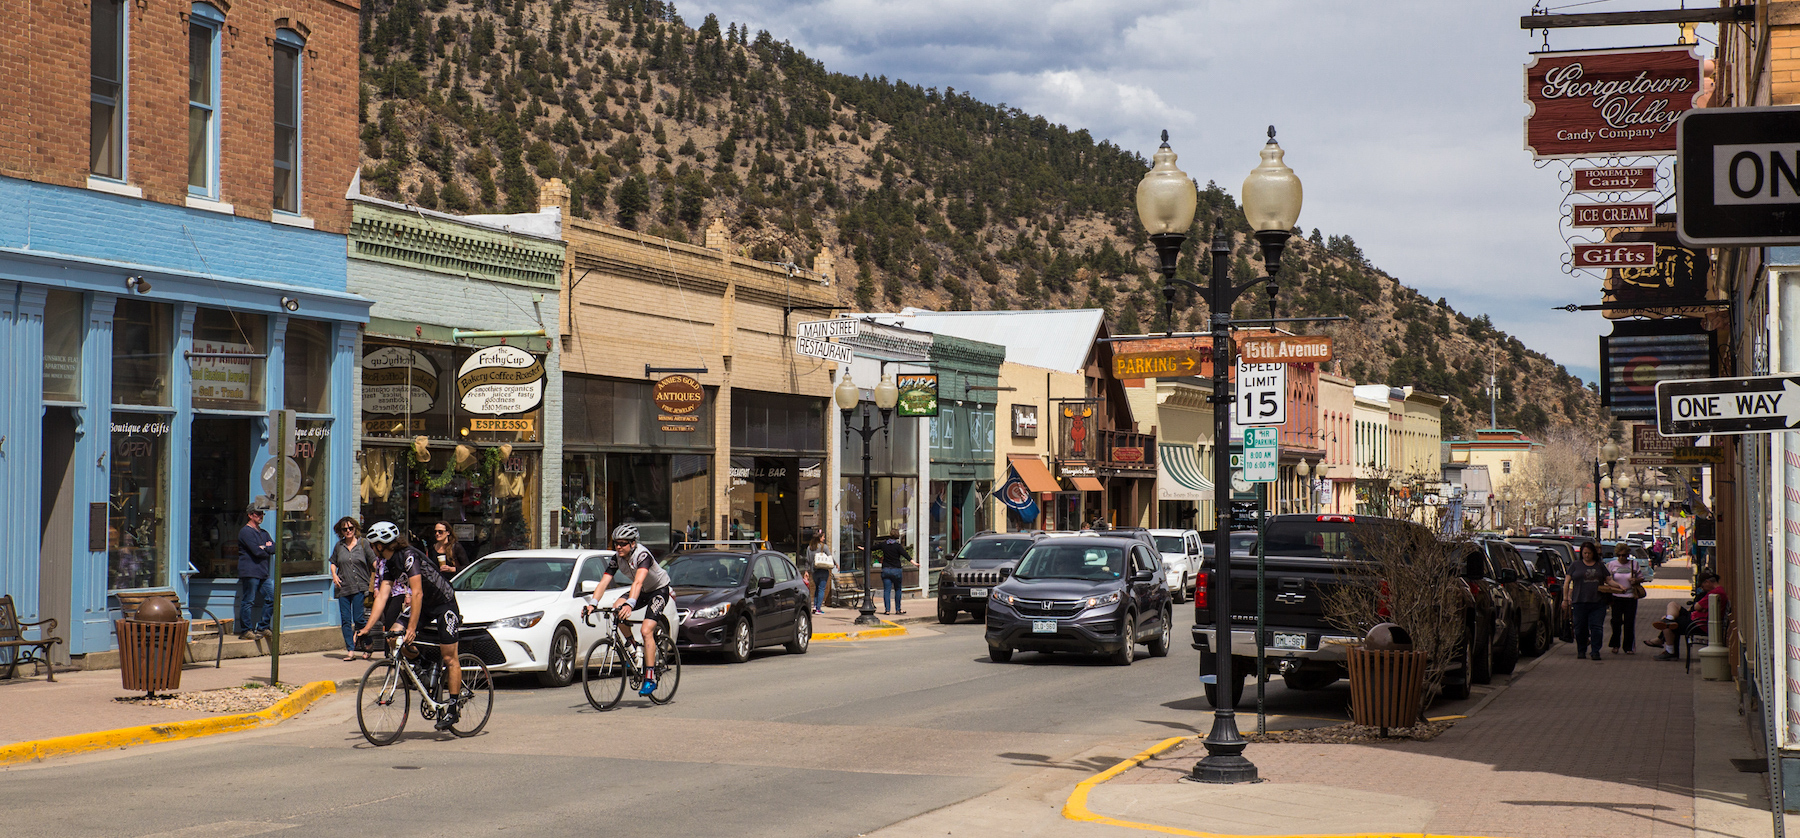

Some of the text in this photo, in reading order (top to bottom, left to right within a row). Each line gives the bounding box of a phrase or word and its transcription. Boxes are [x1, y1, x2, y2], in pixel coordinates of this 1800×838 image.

[1541, 62, 1693, 108] Georgetown
[1602, 95, 1682, 133] Valley
[1557, 126, 1657, 143] Candy Company
[1585, 168, 1644, 178] HOMEMADE
[1588, 176, 1640, 188] Candy
[1578, 207, 1649, 222] ICE CREAM
[1582, 247, 1646, 263] Gifts
[804, 320, 858, 337] MAIN STREET
[799, 337, 851, 362] RESTAURANT
[1279, 340, 1328, 358] Avenue
[1117, 357, 1177, 375] PARKING
[1240, 362, 1283, 373] SPEED
[461, 364, 541, 390] Bakery Coffee Roaster
[658, 375, 700, 391] ANNIE'S GOLD
[1245, 376, 1278, 388] LIMIT
[199, 385, 214, 397] Sell
[220, 386, 244, 398] Trade
[474, 385, 534, 395] smoothies organics
[492, 391, 512, 400] juices
[517, 391, 535, 400] tasty
[656, 392, 701, 402] ANTIQUES
[495, 404, 514, 412] Miner
[1244, 391, 1278, 418] 15
[1677, 393, 1783, 418] ONE WAY
[110, 422, 170, 437] Boutique & Gifts
[476, 420, 529, 430] ESPRESSO
[315, 427, 330, 440] Gifts
[1246, 432, 1254, 446] 3
[1255, 438, 1276, 446] PARKING
[1250, 451, 1272, 459] 8:00 AM
[1254, 461, 1267, 469] 6:00
[1267, 461, 1275, 469] PM
[767, 468, 787, 477] BAR
